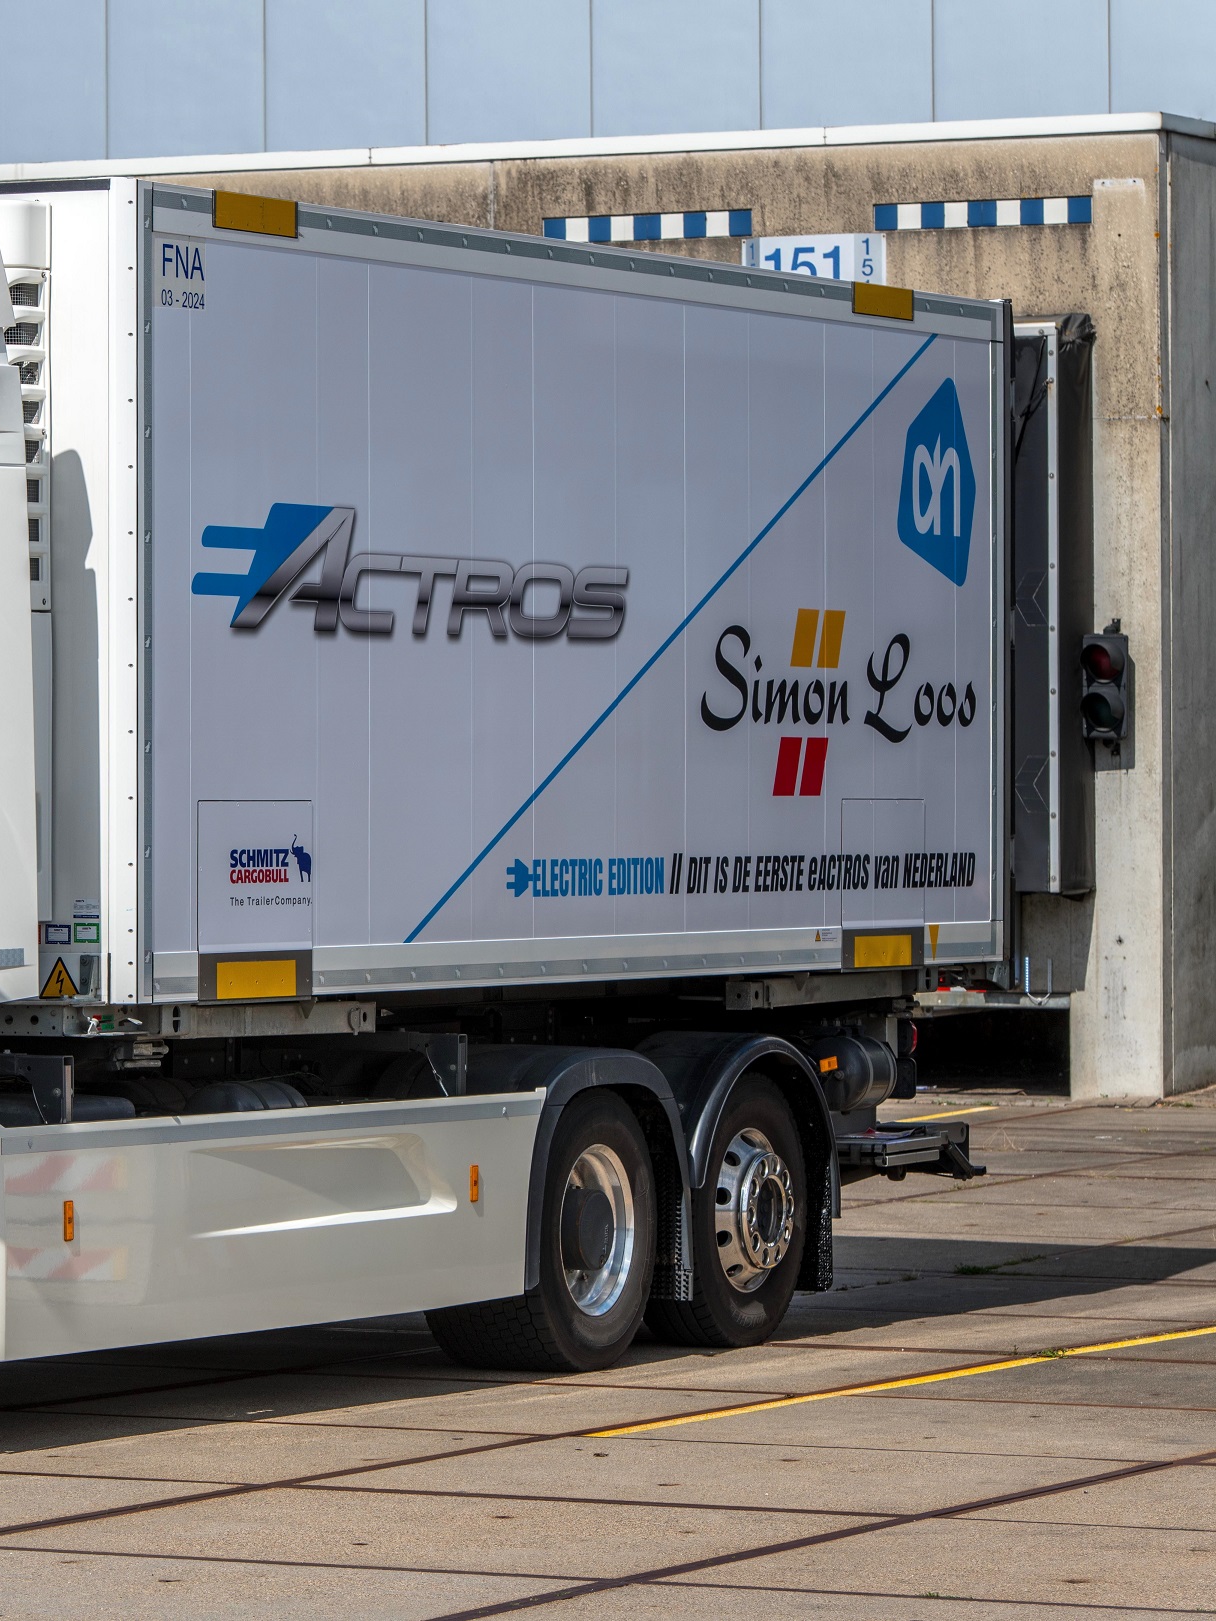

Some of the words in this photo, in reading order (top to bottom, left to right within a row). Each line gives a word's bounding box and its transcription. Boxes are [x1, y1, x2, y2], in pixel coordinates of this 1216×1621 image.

[163, 243, 204, 281] FNA
[161, 289, 173, 306] 03
[182, 291, 205, 310] 2024
[700, 624, 850, 731] Simon
[864, 633, 976, 743] Loos
[230, 849, 289, 868] SCHMITZ
[230, 869, 289, 884] CARGOBULL
[533, 858, 603, 897] ELECTRIC
[608, 857, 664, 896] EDITION
[686, 856, 711, 893] DIT
[714, 856, 729, 894] IS
[732, 856, 751, 893] DE
[754, 855, 805, 893] EERSTE
[902, 852, 976, 888] NEDERLAND
[230, 897, 244, 906] The
